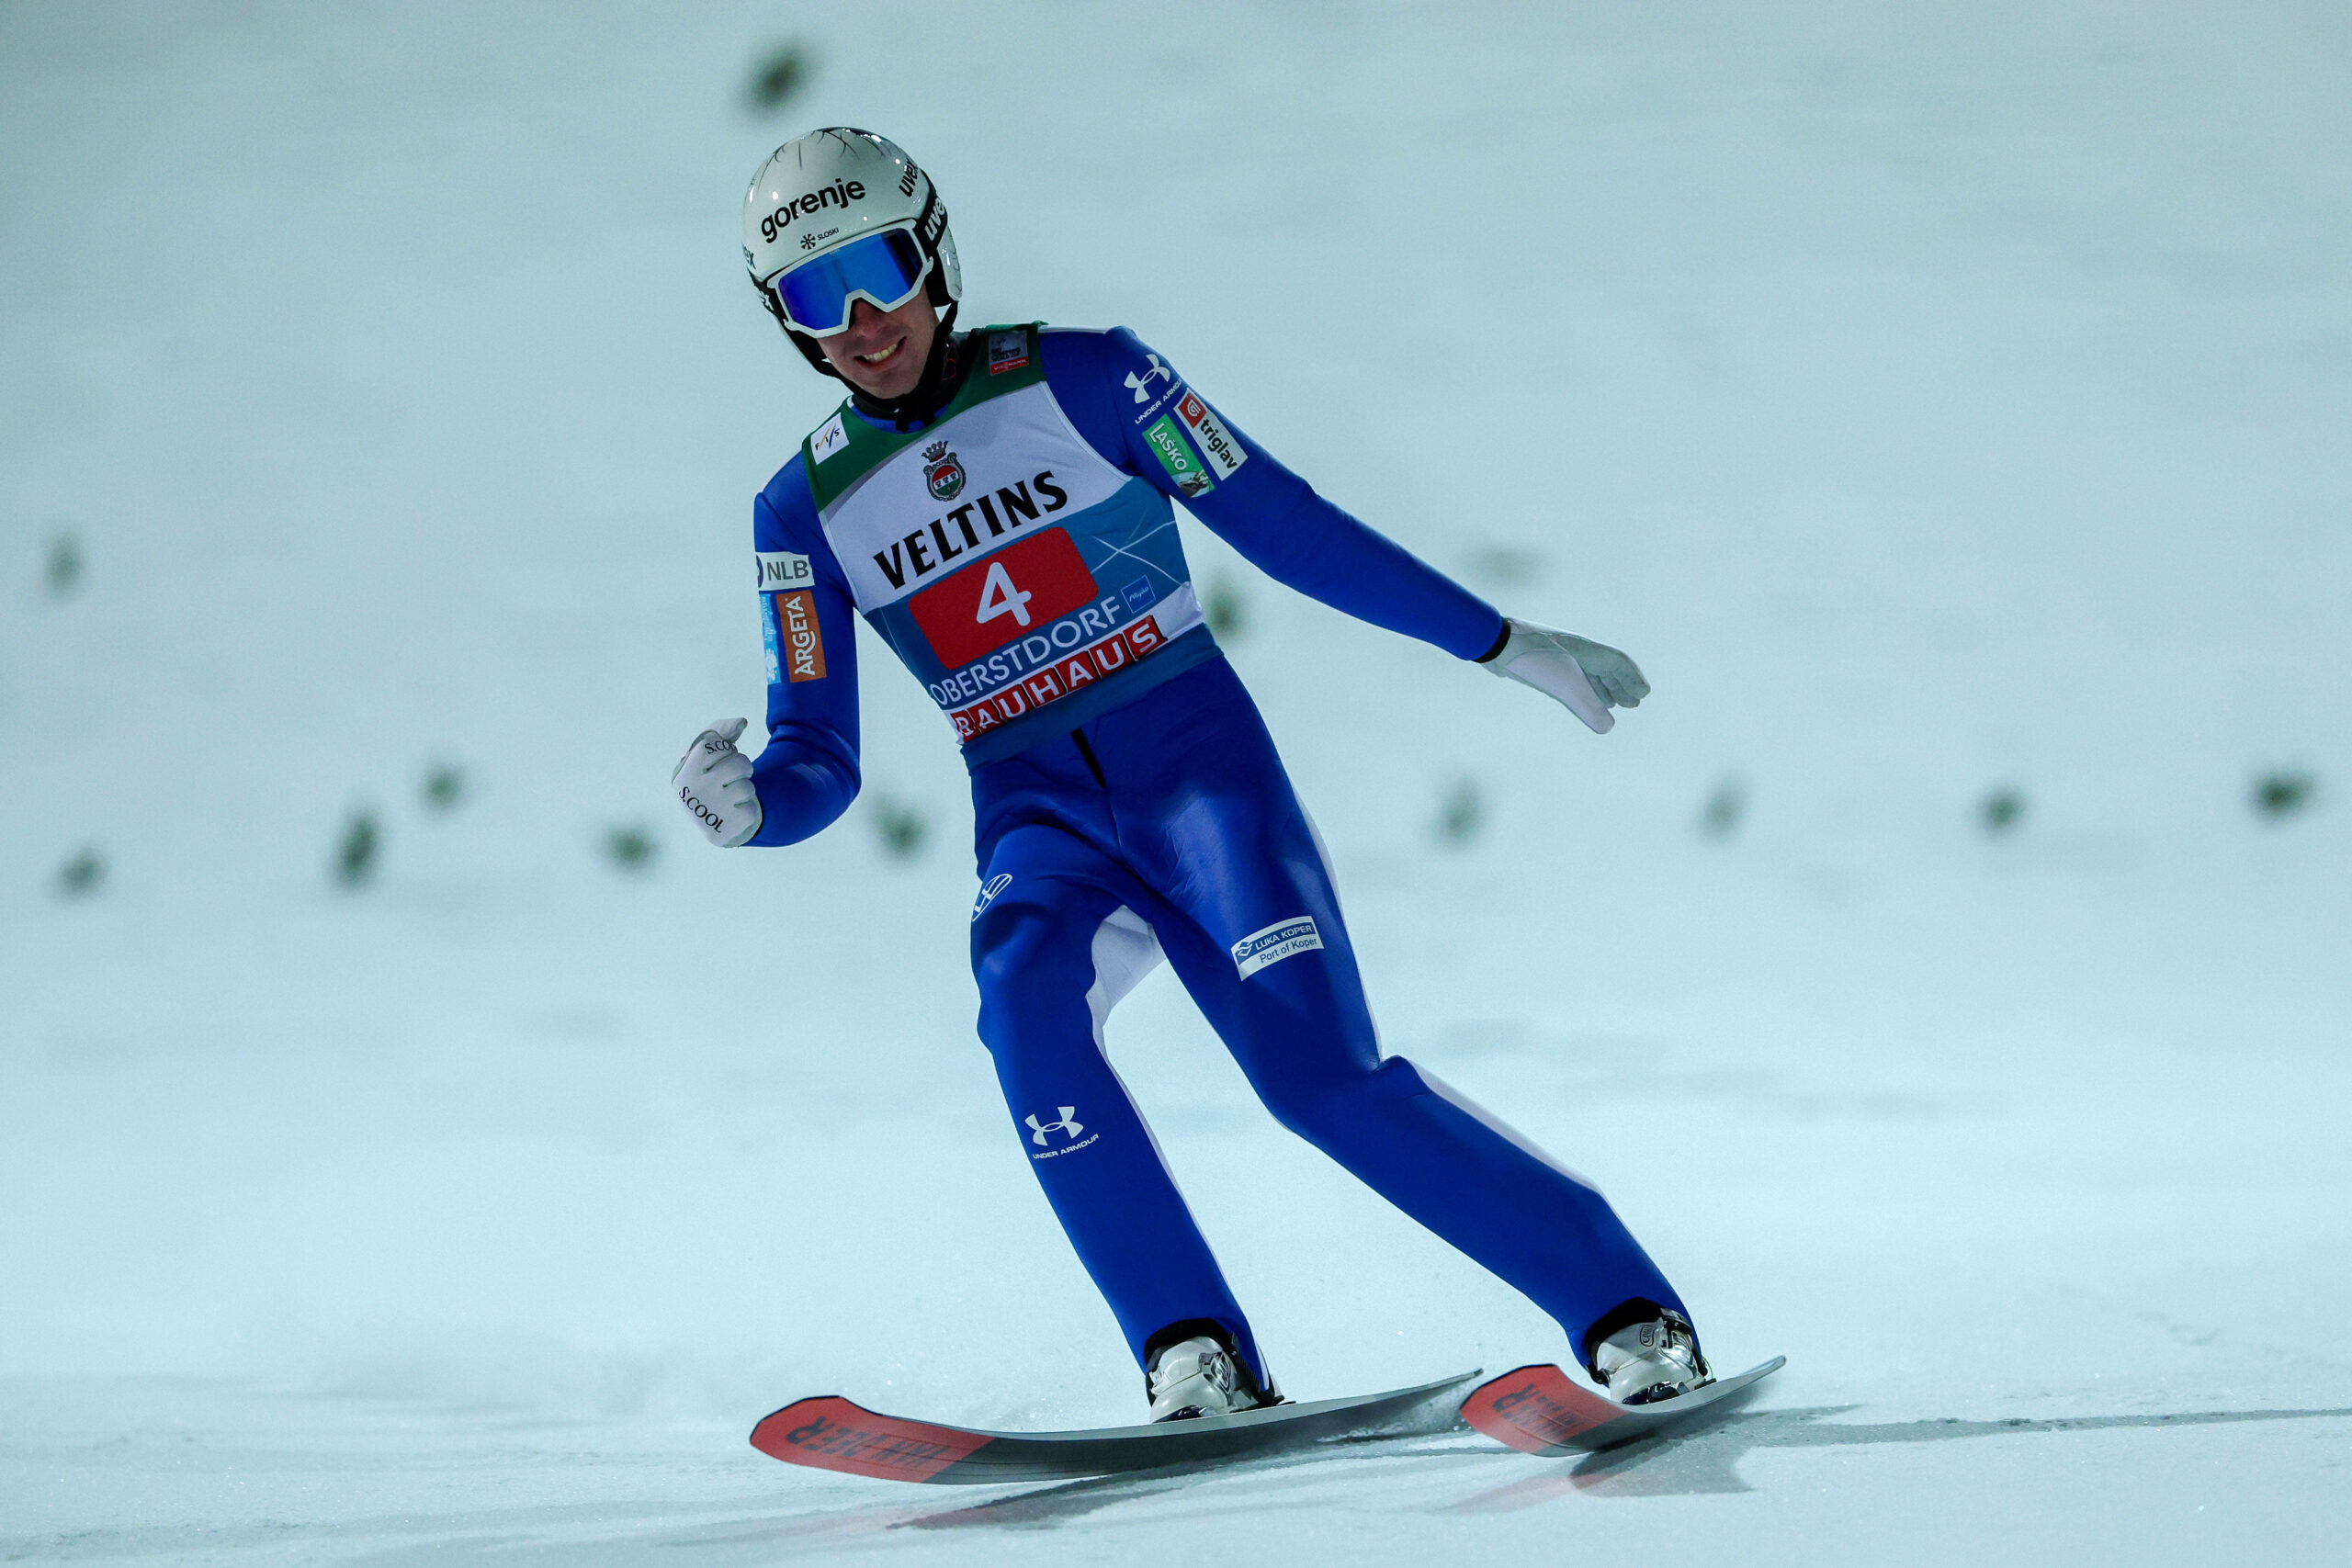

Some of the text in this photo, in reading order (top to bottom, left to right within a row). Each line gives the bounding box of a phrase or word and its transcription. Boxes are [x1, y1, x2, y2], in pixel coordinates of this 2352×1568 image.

[761, 178, 866, 243] gorenje
[924, 197, 945, 241] uve
[1135, 400, 1162, 424] UNDER
[1200, 419, 1238, 469] triglav
[872, 470, 1068, 590] VELTINS
[766, 559, 809, 581] NLB
[976, 561, 1032, 626] 4
[786, 595, 817, 676] ARGETA
[930, 595, 1121, 705] OBERSTDORF
[956, 624, 1158, 737] BAUHAUS
[679, 786, 724, 833] S.COOL
[1255, 925, 1313, 951] LUKA KOPER
[1260, 938, 1317, 964] Port of Koper
[1033, 1134, 1100, 1159] UNDER ARMOUR
